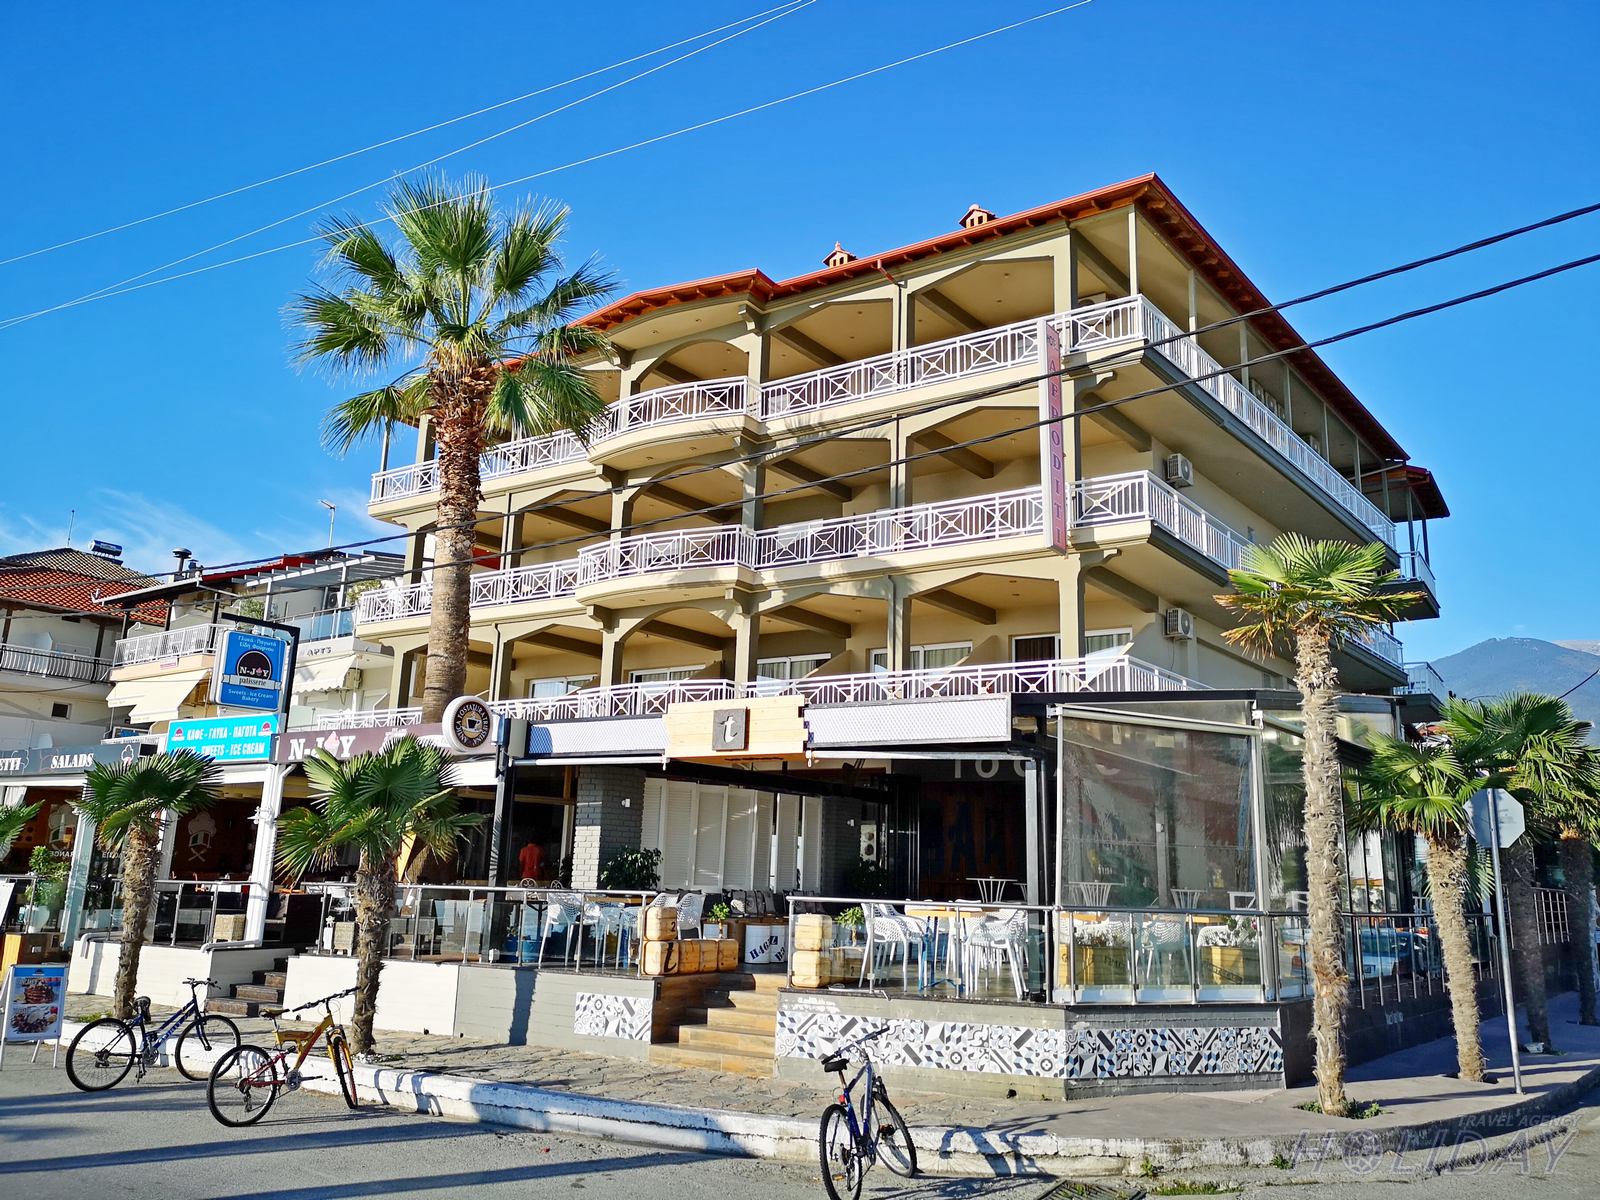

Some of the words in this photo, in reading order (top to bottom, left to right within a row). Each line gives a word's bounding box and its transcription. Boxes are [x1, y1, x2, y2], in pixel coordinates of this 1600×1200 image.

[720, 715, 738, 744] t
[230, 743, 242, 756] ICE
[242, 742, 265, 755] CREAM
[50, 753, 94, 768] SALADS
